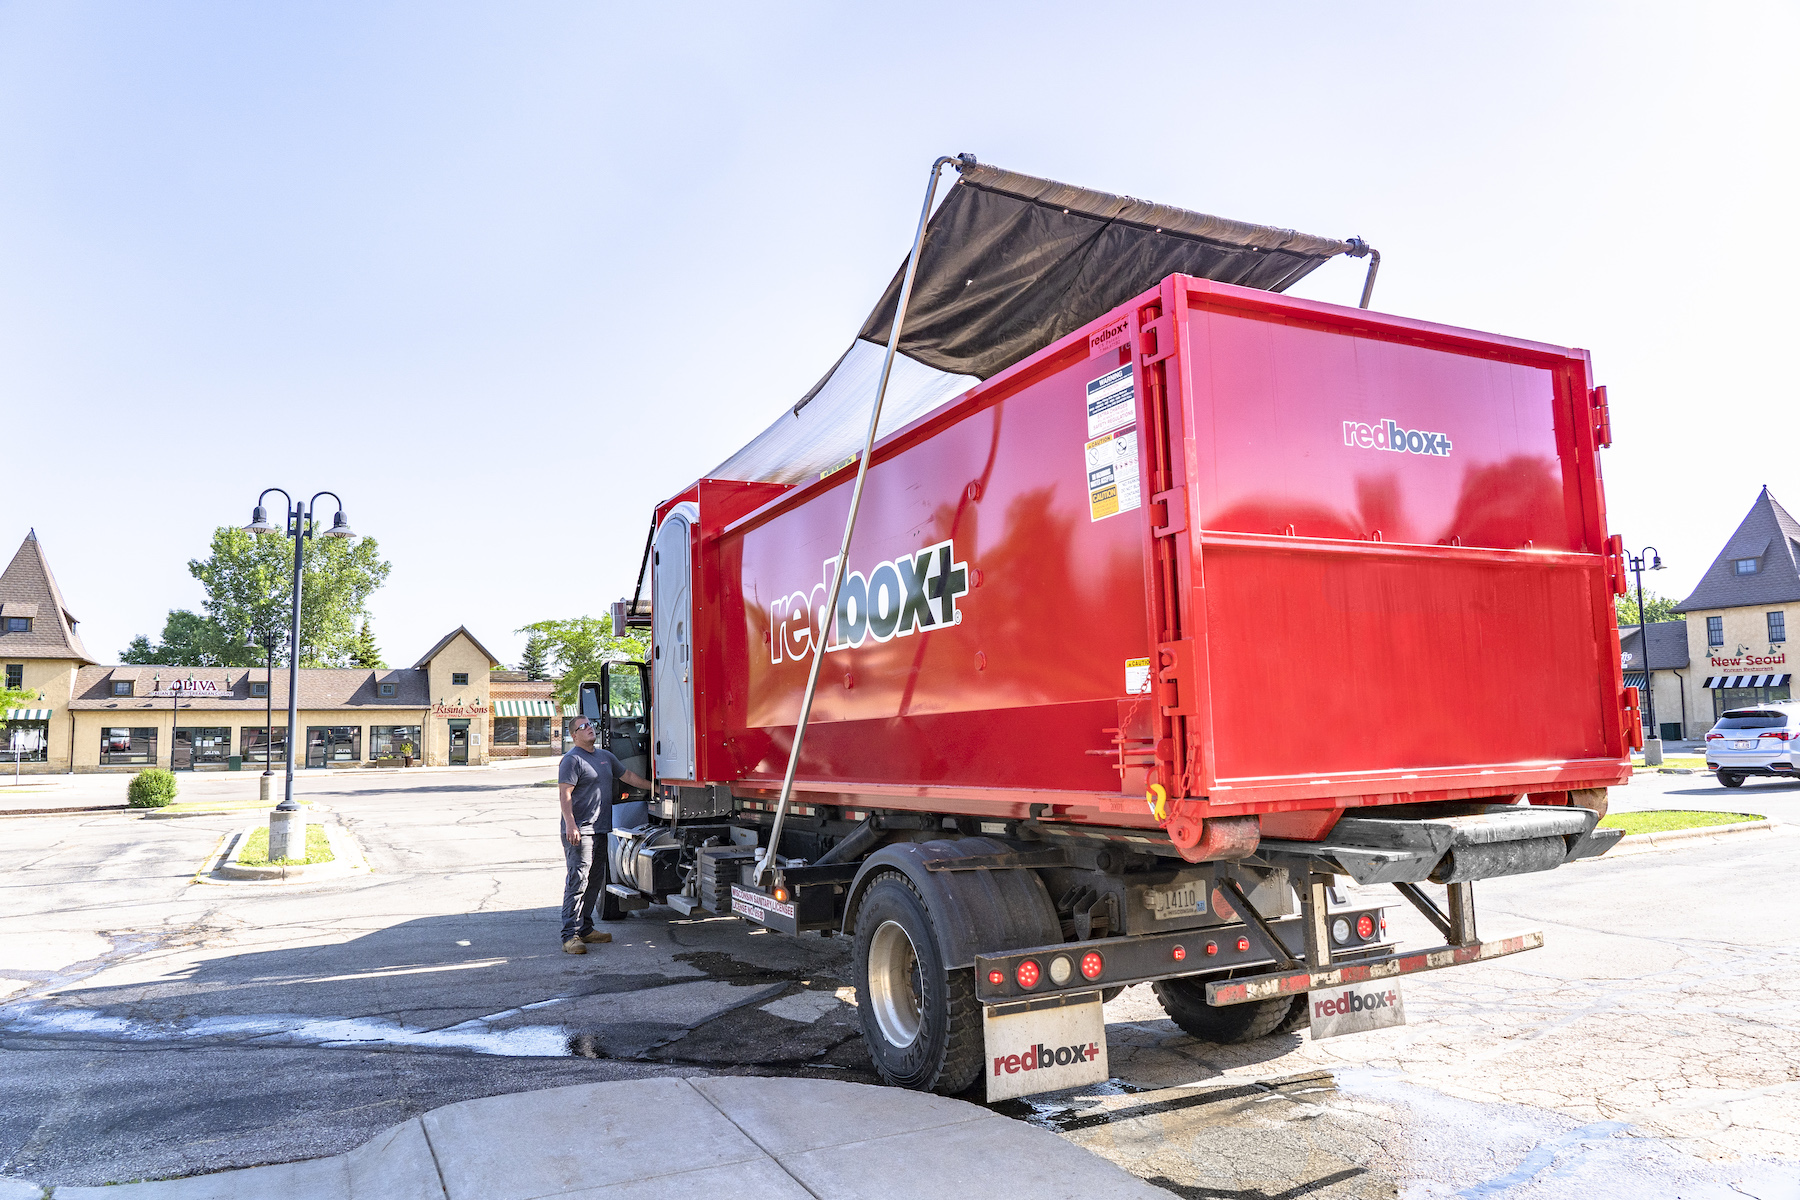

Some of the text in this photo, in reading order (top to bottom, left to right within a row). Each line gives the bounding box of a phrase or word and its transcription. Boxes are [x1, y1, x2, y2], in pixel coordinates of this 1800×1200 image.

[1091, 436, 1111, 448] CAUTION
[1092, 487, 1116, 502] CAUTION
[1711, 653, 1785, 667] New Seoul
[172, 680, 217, 691] OLIVA
[432, 704, 488, 717] Rising Sons
[732, 888, 794, 916] WISCONSIN SANITARY LICENSEE
[732, 901, 748, 913] LICENSE
